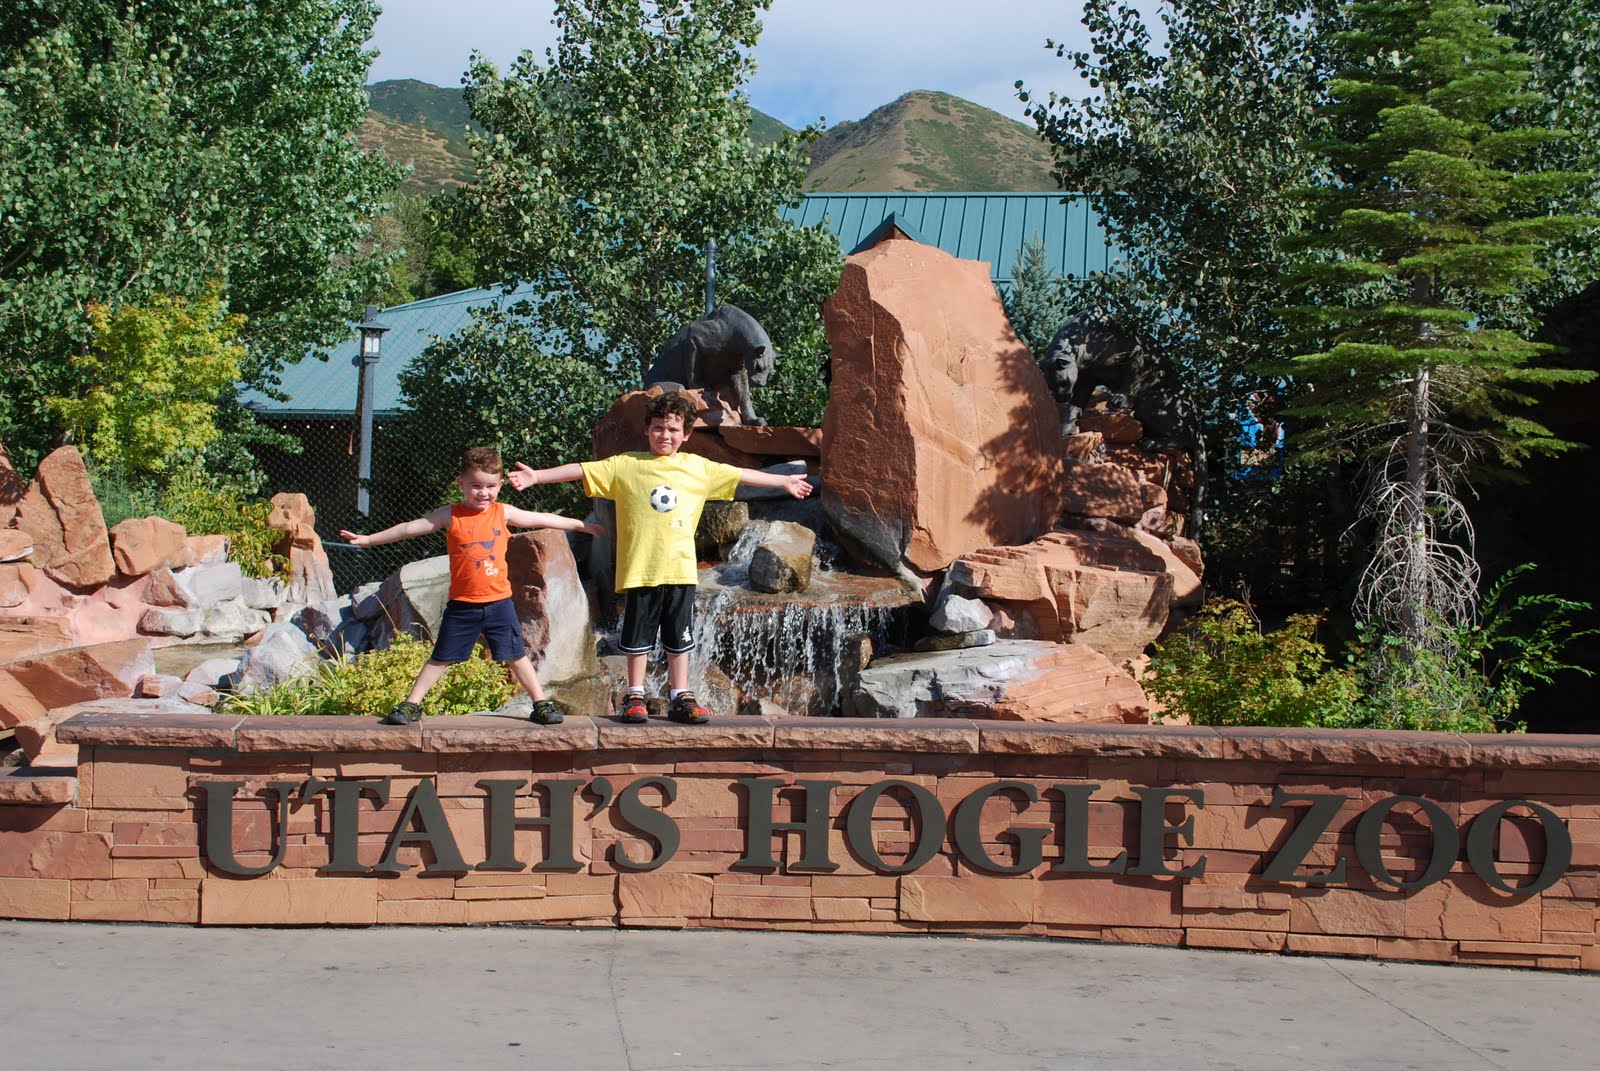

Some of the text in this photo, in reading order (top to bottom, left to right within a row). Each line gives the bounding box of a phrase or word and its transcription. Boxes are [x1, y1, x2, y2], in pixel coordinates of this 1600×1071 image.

[197, 776, 1573, 895] UTAH'S HOGLE ZOO
